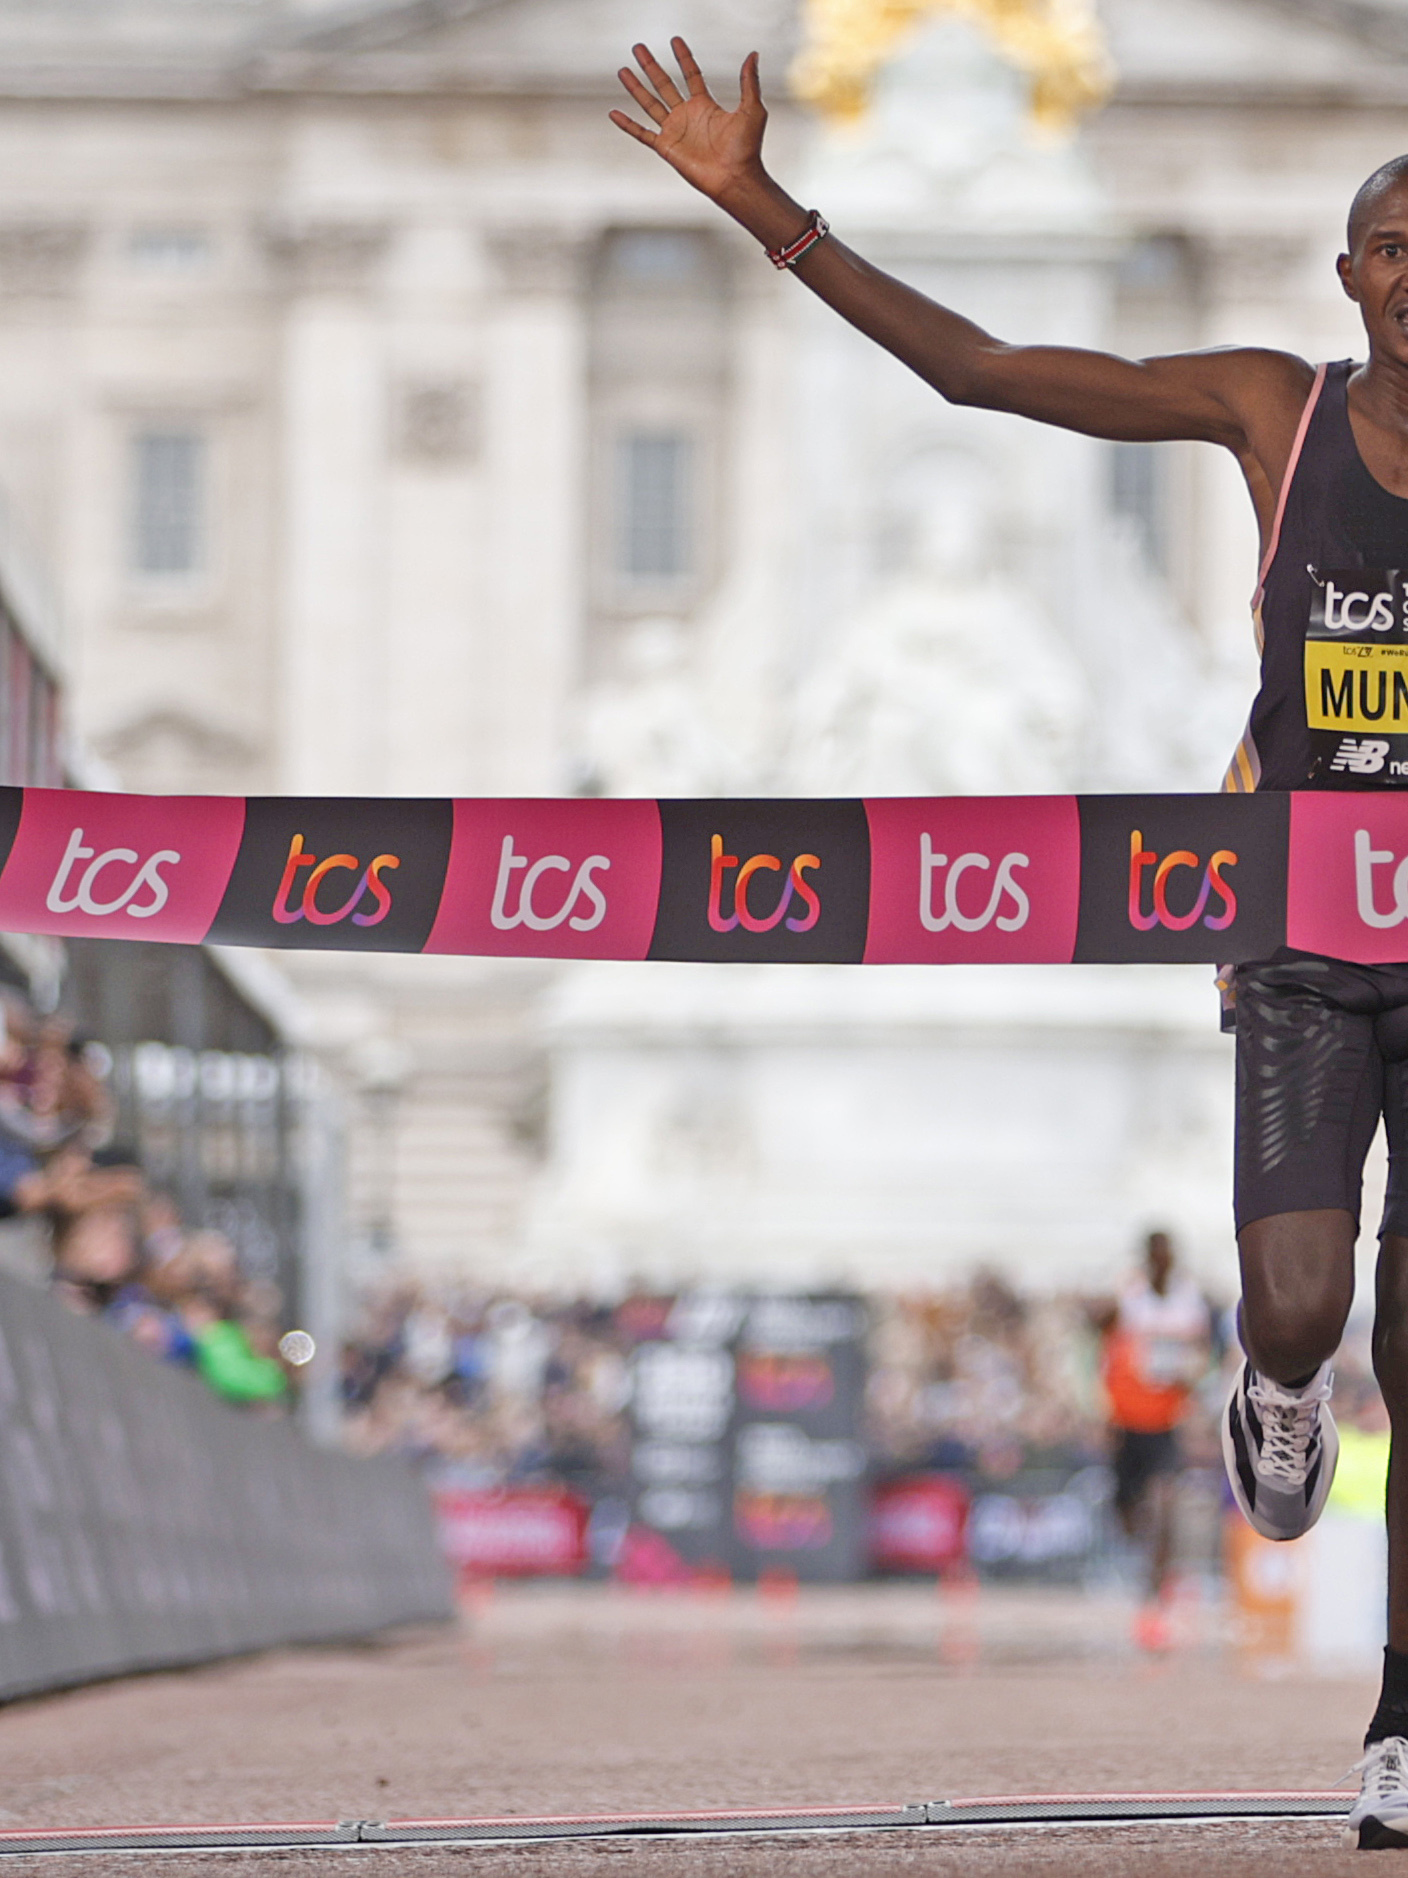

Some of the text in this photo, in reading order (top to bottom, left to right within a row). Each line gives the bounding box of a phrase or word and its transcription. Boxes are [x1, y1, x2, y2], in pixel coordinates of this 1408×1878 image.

[1324, 581, 1395, 632] tcs
[46, 828, 181, 918] tcs
[272, 833, 400, 926] tcs
[491, 835, 611, 931] tcs
[707, 834, 821, 933] tcs
[919, 832, 1030, 932] tcs
[1128, 829, 1238, 931] tcs
